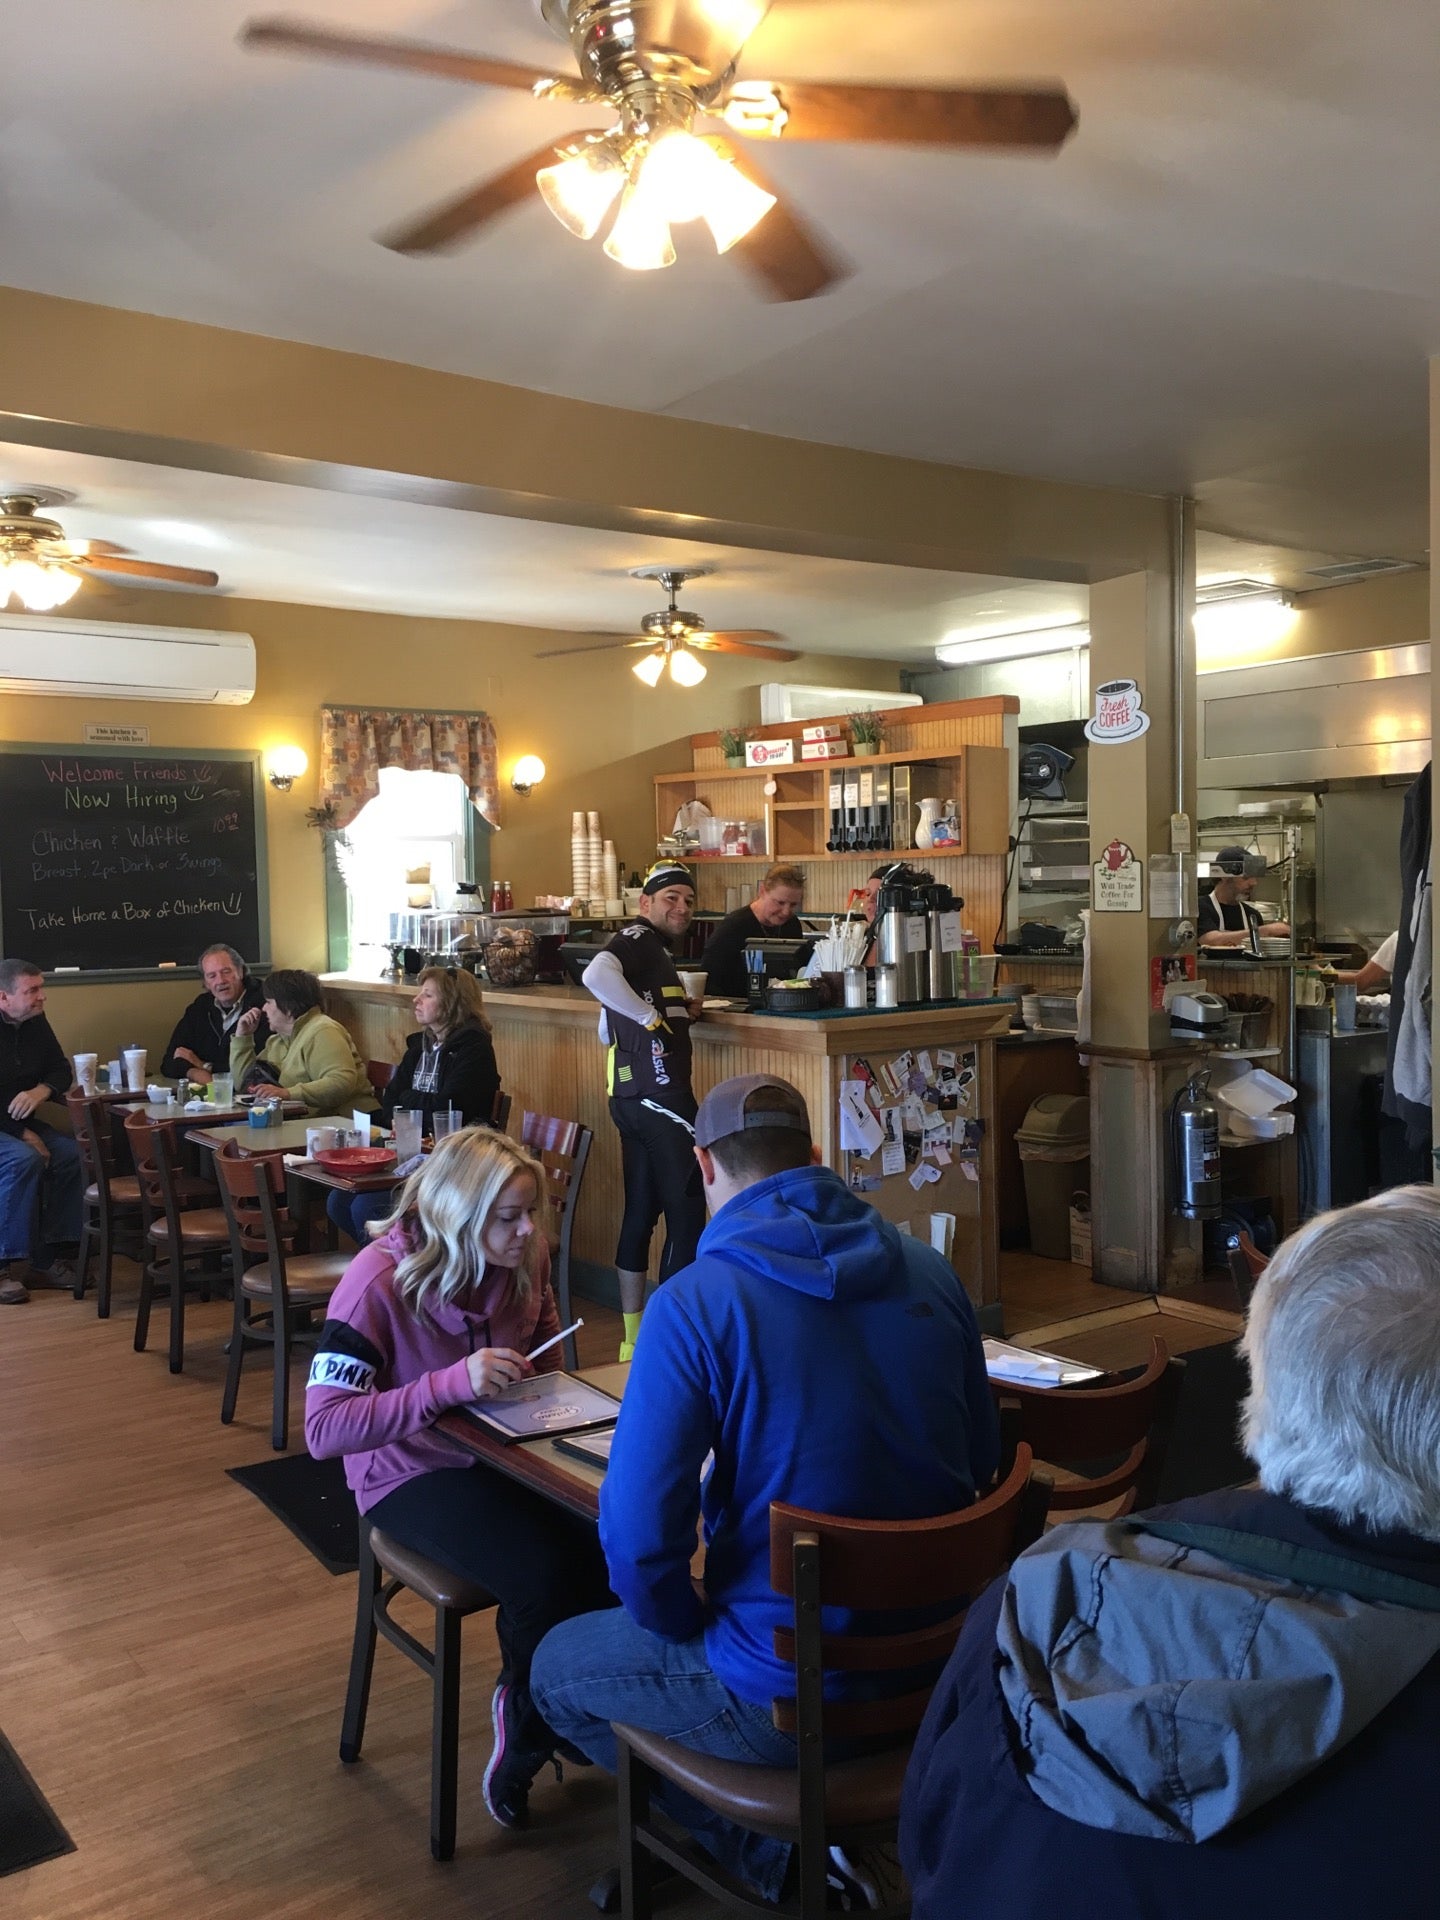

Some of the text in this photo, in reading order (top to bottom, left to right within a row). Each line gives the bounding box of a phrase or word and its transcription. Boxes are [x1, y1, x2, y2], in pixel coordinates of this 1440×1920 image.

[1100, 695, 1129, 712] Fresh
[1099, 707, 1131, 728] COFFEE
[41, 759, 187, 783] Welcome Friends
[65, 784, 177, 814] Now Hiring
[128, 825, 191, 848] Waffle
[120, 856, 154, 873] Dark
[158, 861, 169, 870] or
[1100, 882, 1135, 890] Will Trade
[1100, 890, 1135, 899] Coffee For
[17, 897, 220, 931] Take Home a Box of Chicken
[1106, 899, 1129, 908] Gossip
[324, 1359, 372, 1390] PINK
